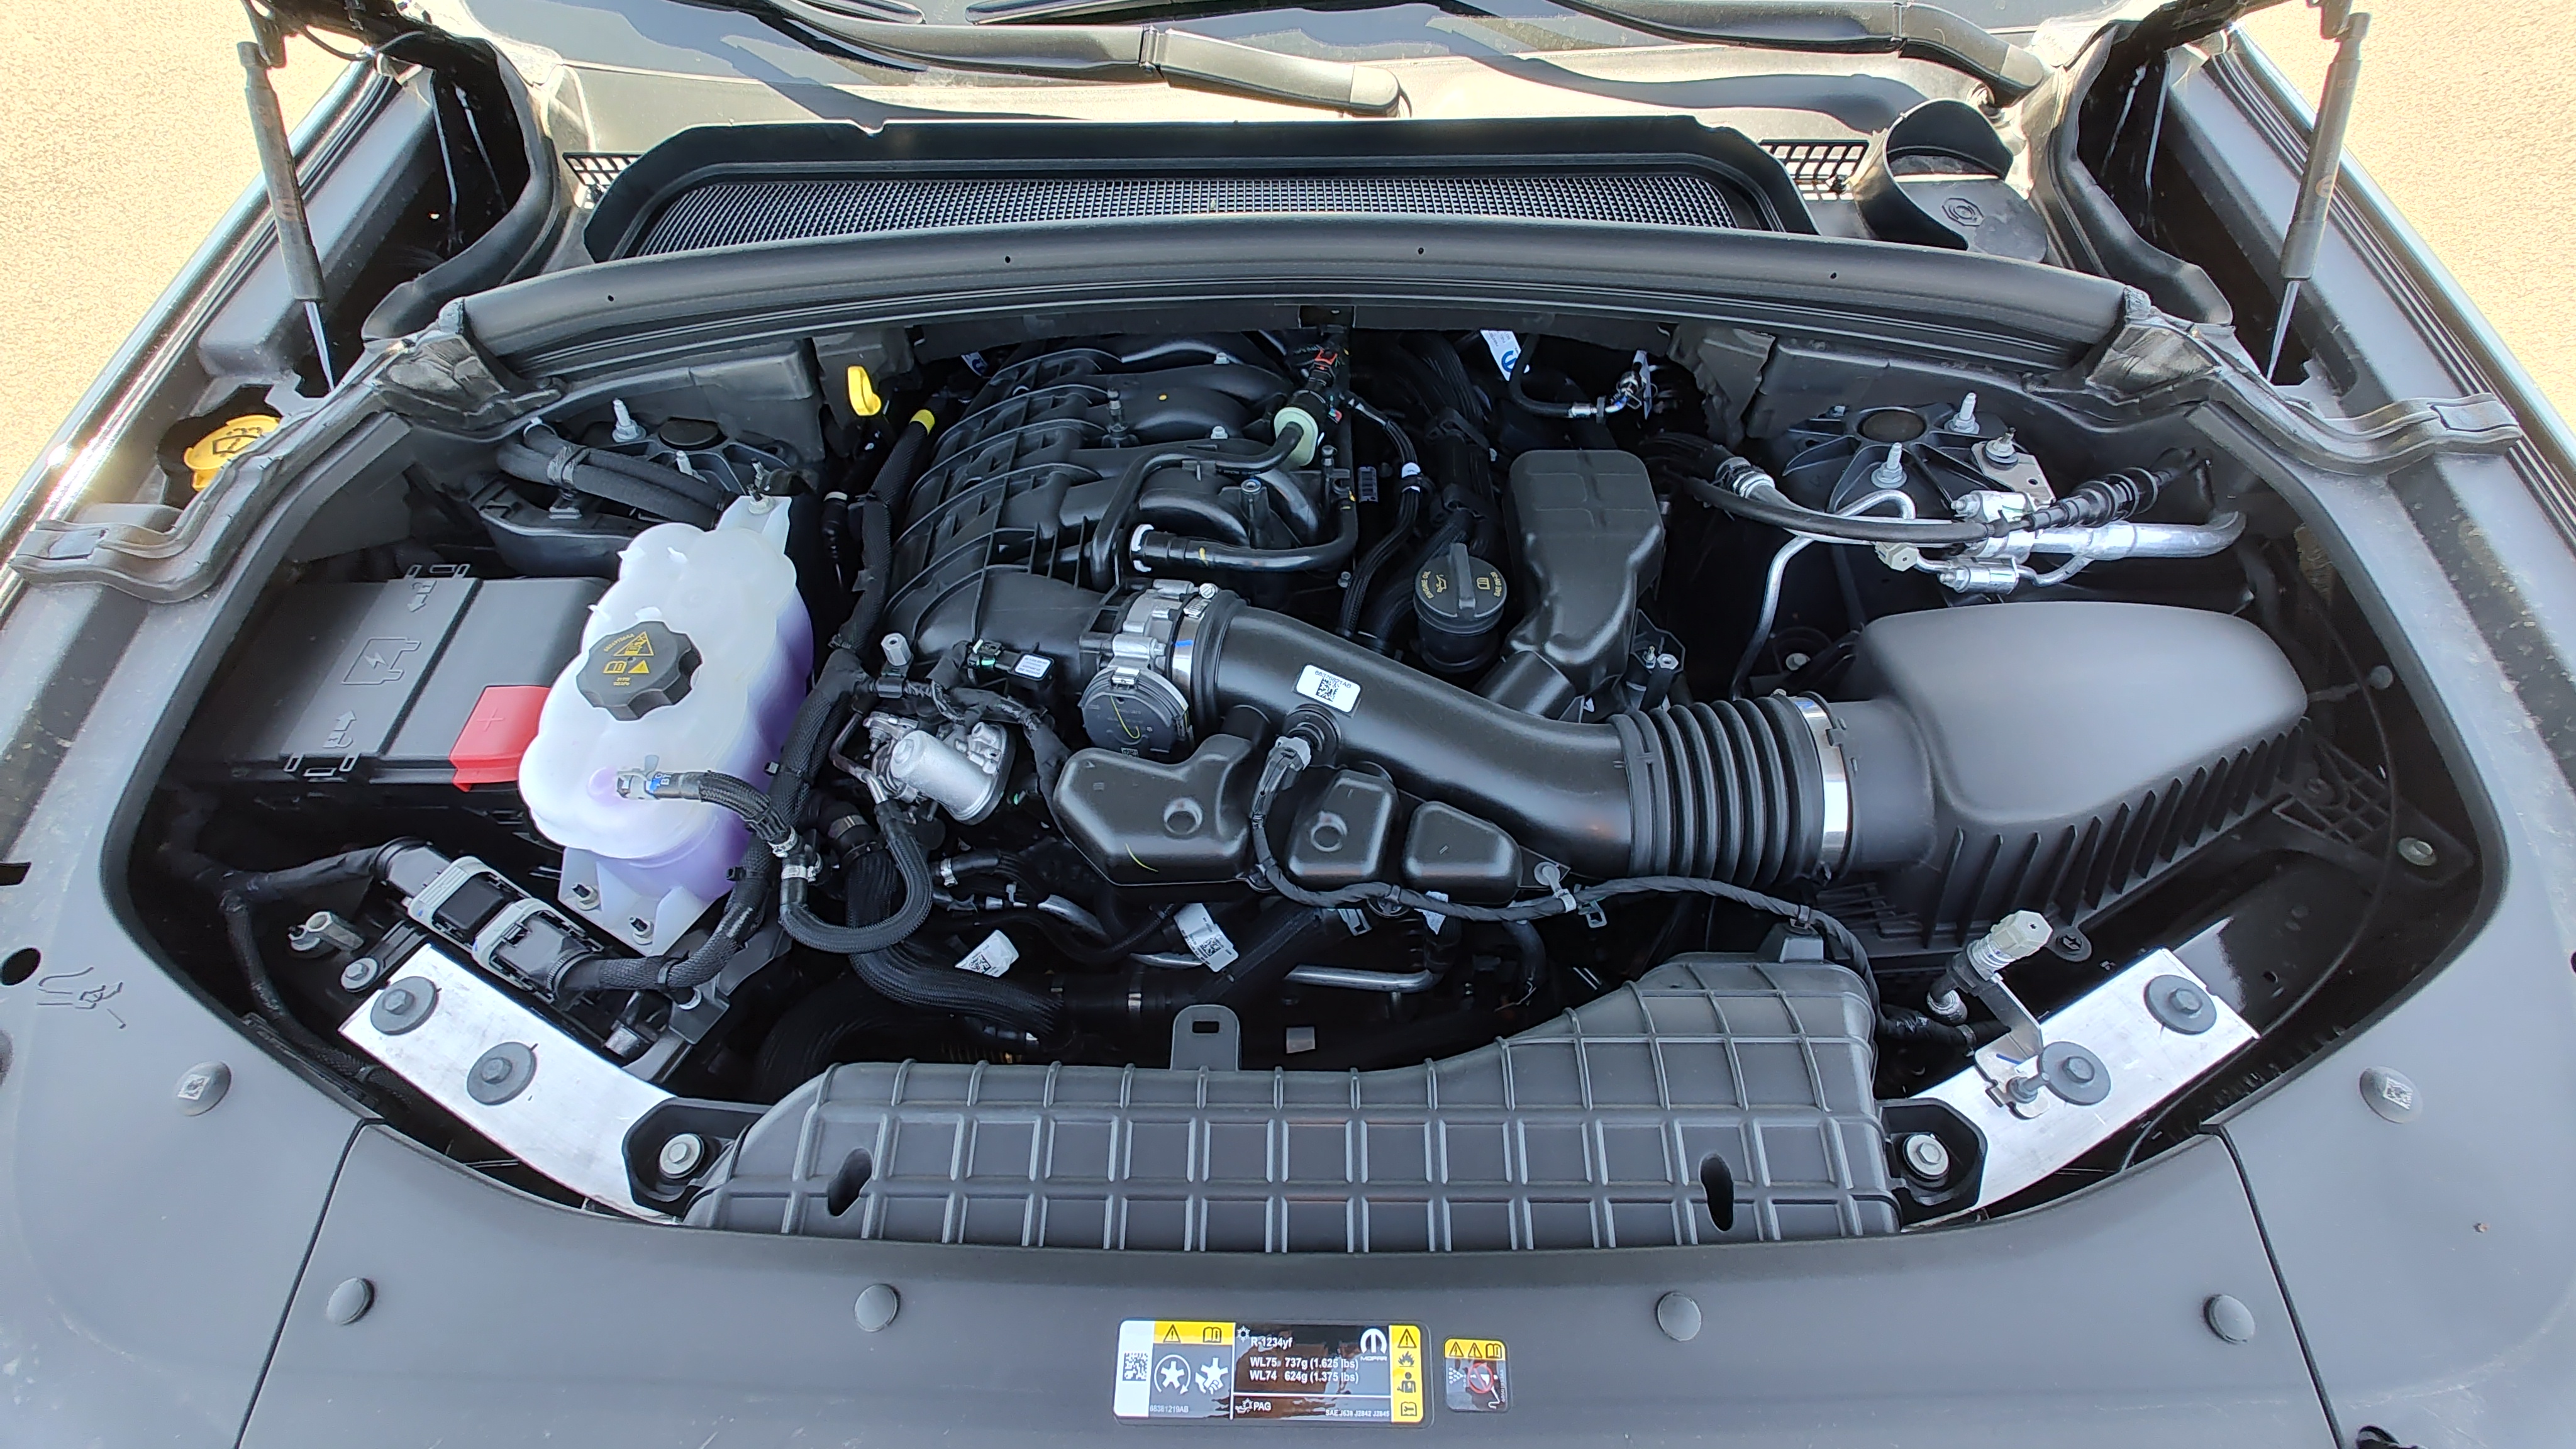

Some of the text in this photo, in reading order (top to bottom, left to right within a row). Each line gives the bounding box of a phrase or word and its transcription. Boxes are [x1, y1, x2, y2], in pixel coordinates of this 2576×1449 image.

[1421, 570, 1434, 599] ENGINE OIL
[1493, 586, 1502, 597] SAE
[1250, 1336, 1293, 1350] R-1234yf
[1250, 1357, 1359, 1371] WL75 737g (1.625 lbs)
[1249, 1370, 1360, 1384] WL74 624g (1.375 lbs)
[1253, 1402, 1272, 1411] PAG
